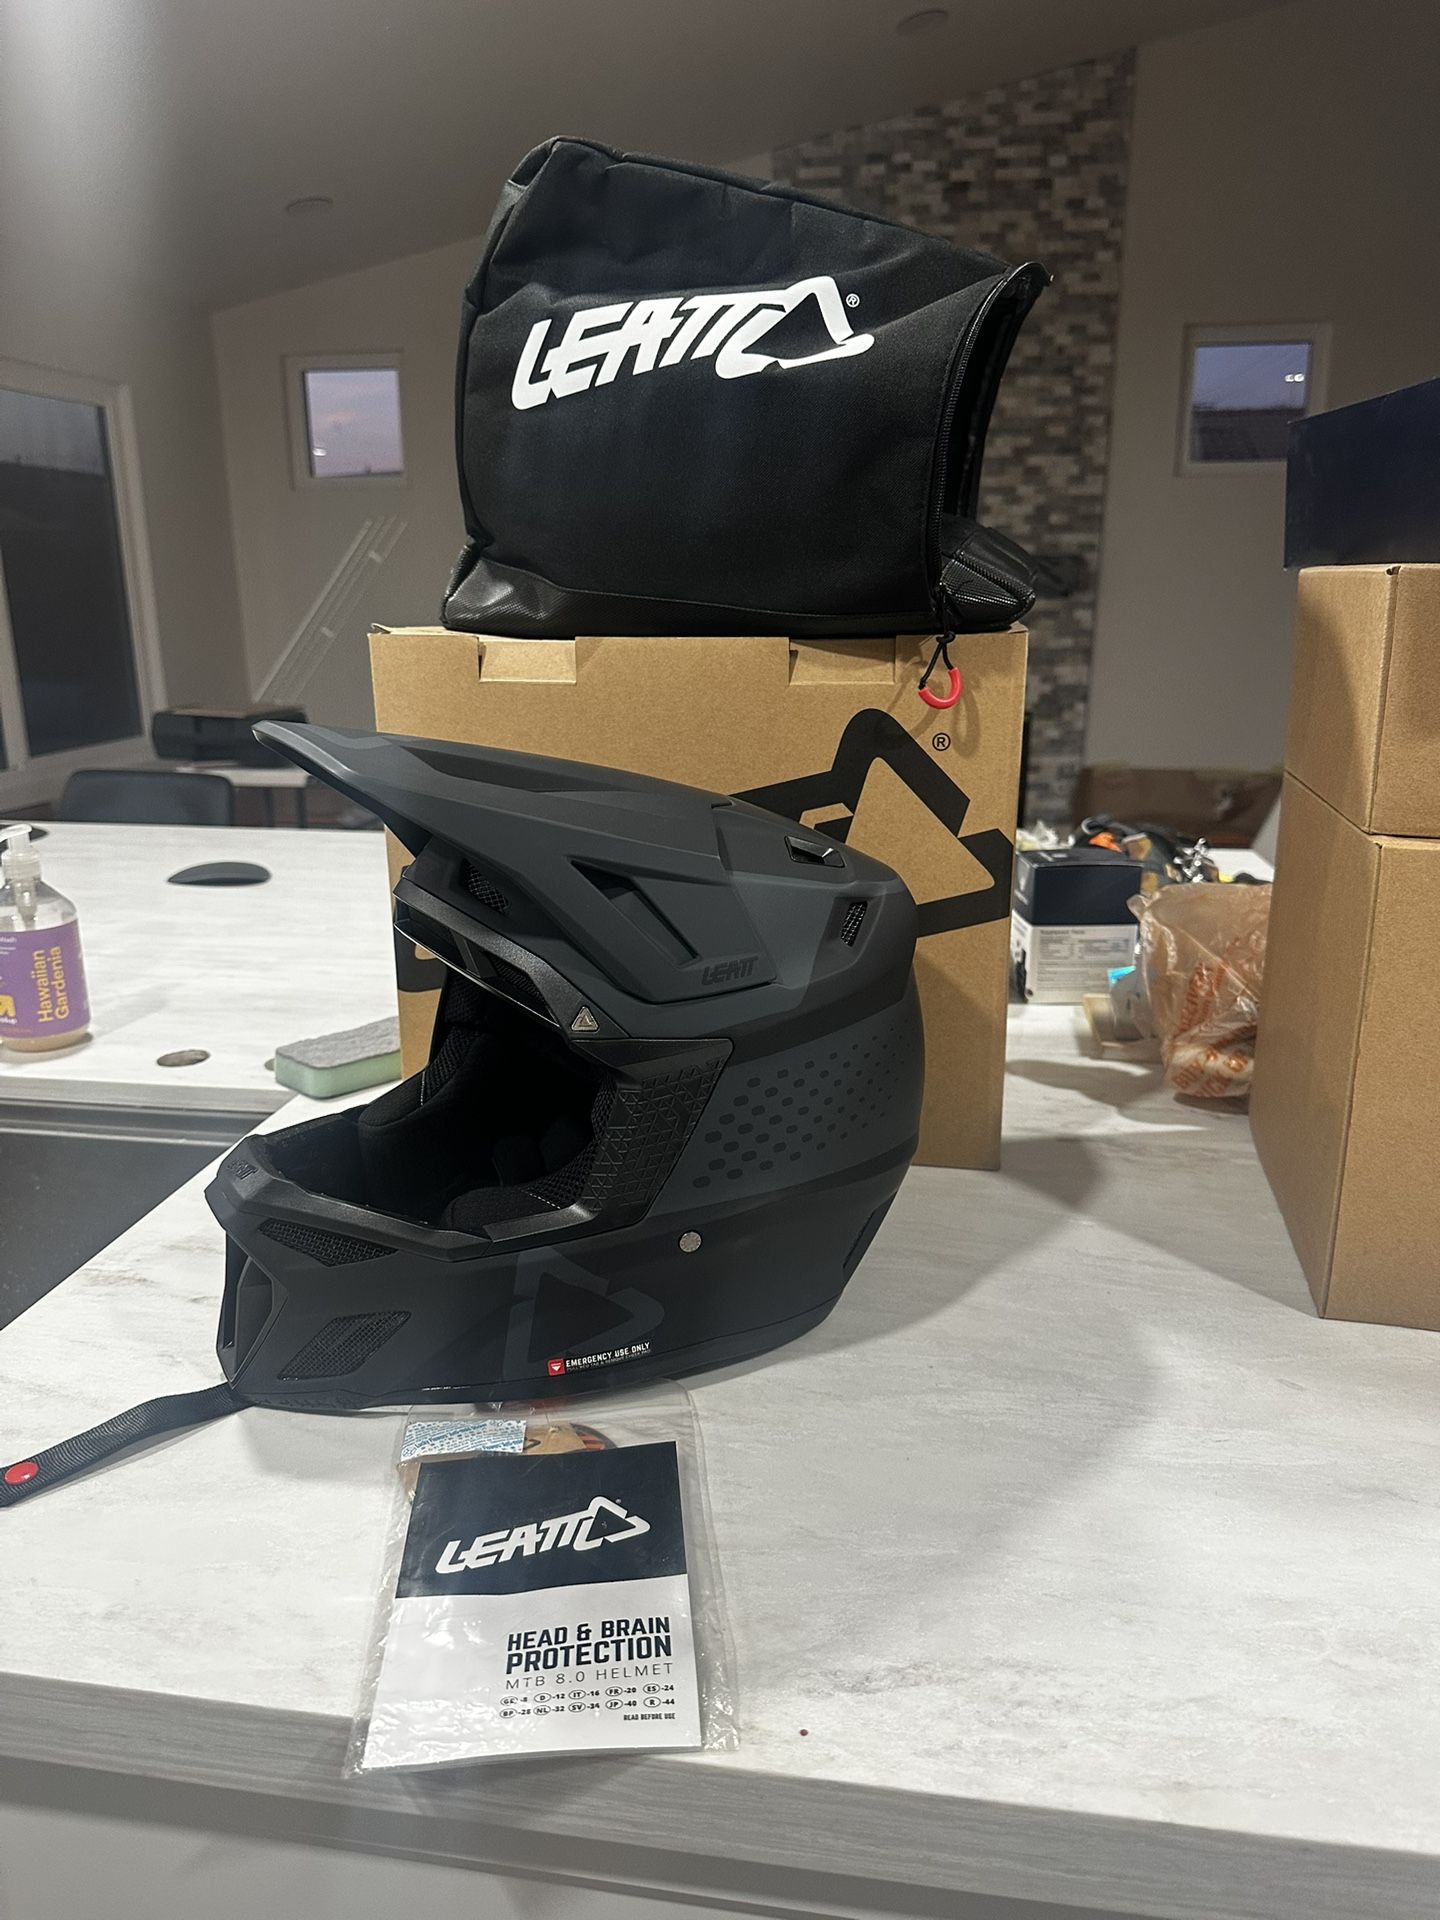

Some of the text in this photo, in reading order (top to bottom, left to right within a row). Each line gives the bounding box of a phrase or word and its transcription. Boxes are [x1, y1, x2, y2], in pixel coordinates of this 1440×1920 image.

[511, 282, 805, 410] LEATT
[32, 949, 54, 1023] Hawaiian
[48, 946, 70, 1019] Gardenia
[701, 956, 758, 986] LEATT
[566, 1351, 612, 1368] EMERGENCY
[614, 1347, 629, 1358] USE
[631, 1341, 650, 1353] ONLY
[435, 1504, 608, 1574] LEATT
[507, 1616, 670, 1651] HEAD & BRAIN
[505, 1635, 672, 1675] PROTECTION
[505, 1662, 673, 1690] MTB 8.0 HELMET
[640, 1712, 663, 1720] BEFORE
